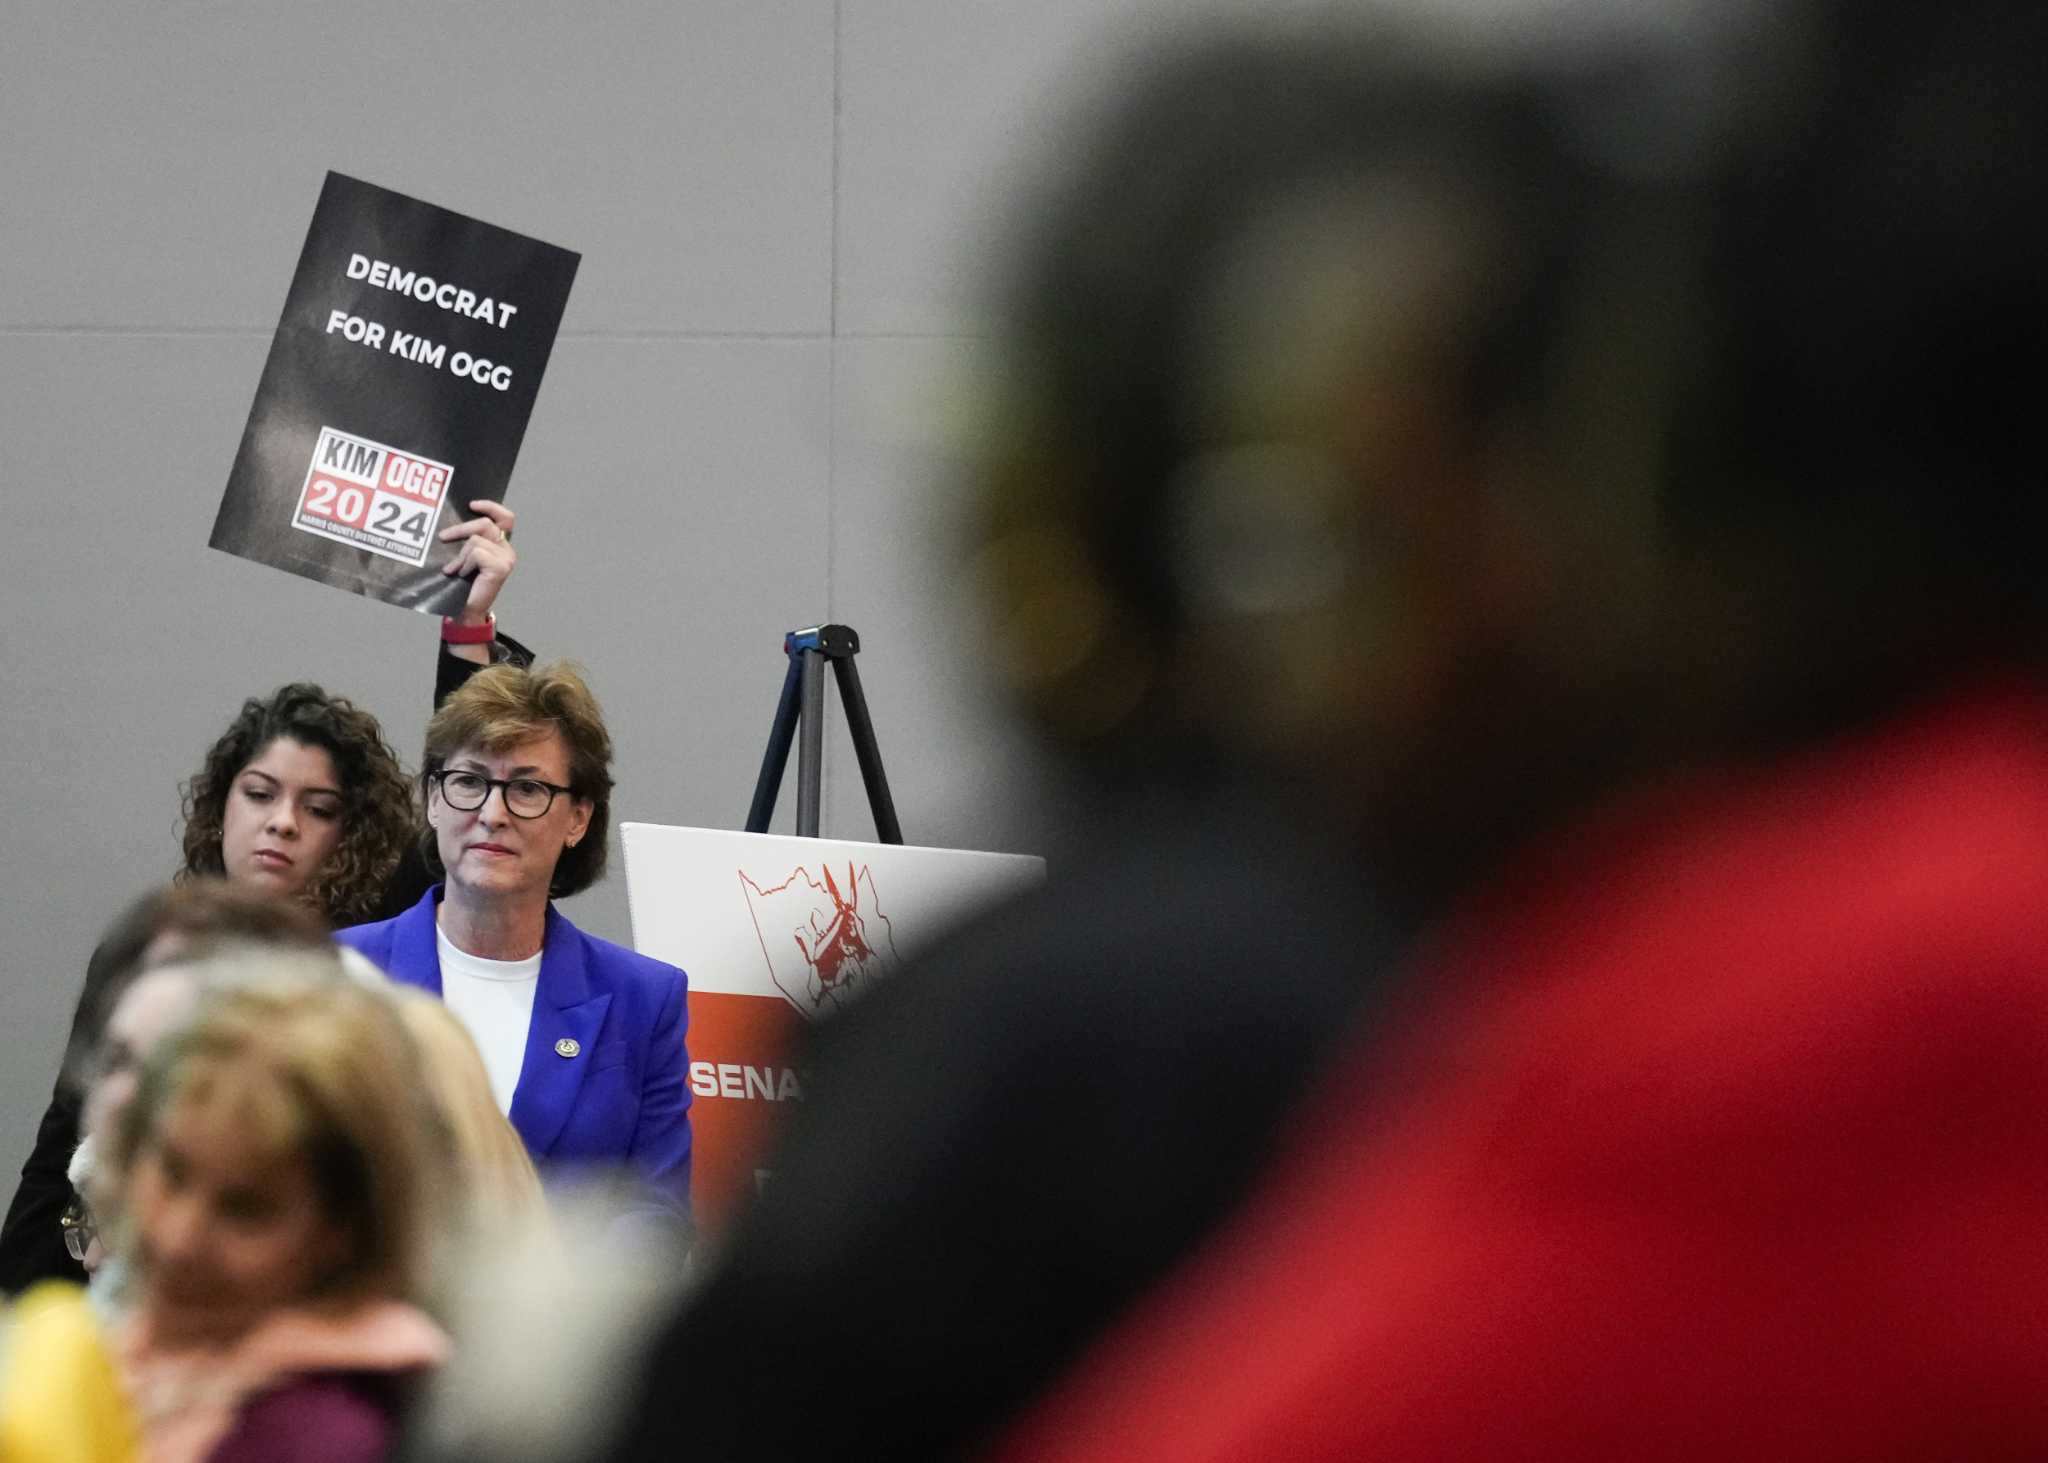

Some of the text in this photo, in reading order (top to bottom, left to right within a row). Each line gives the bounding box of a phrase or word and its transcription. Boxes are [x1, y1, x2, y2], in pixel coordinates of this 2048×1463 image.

[346, 253, 518, 328] DEMOCRAT
[326, 310, 513, 391] FOR KIM OGG
[323, 437, 444, 500] KIM OGG
[301, 513, 421, 557] HARRIS COUNTY DISTRICT ATTORNEY
[690, 1061, 808, 1101] SENA
